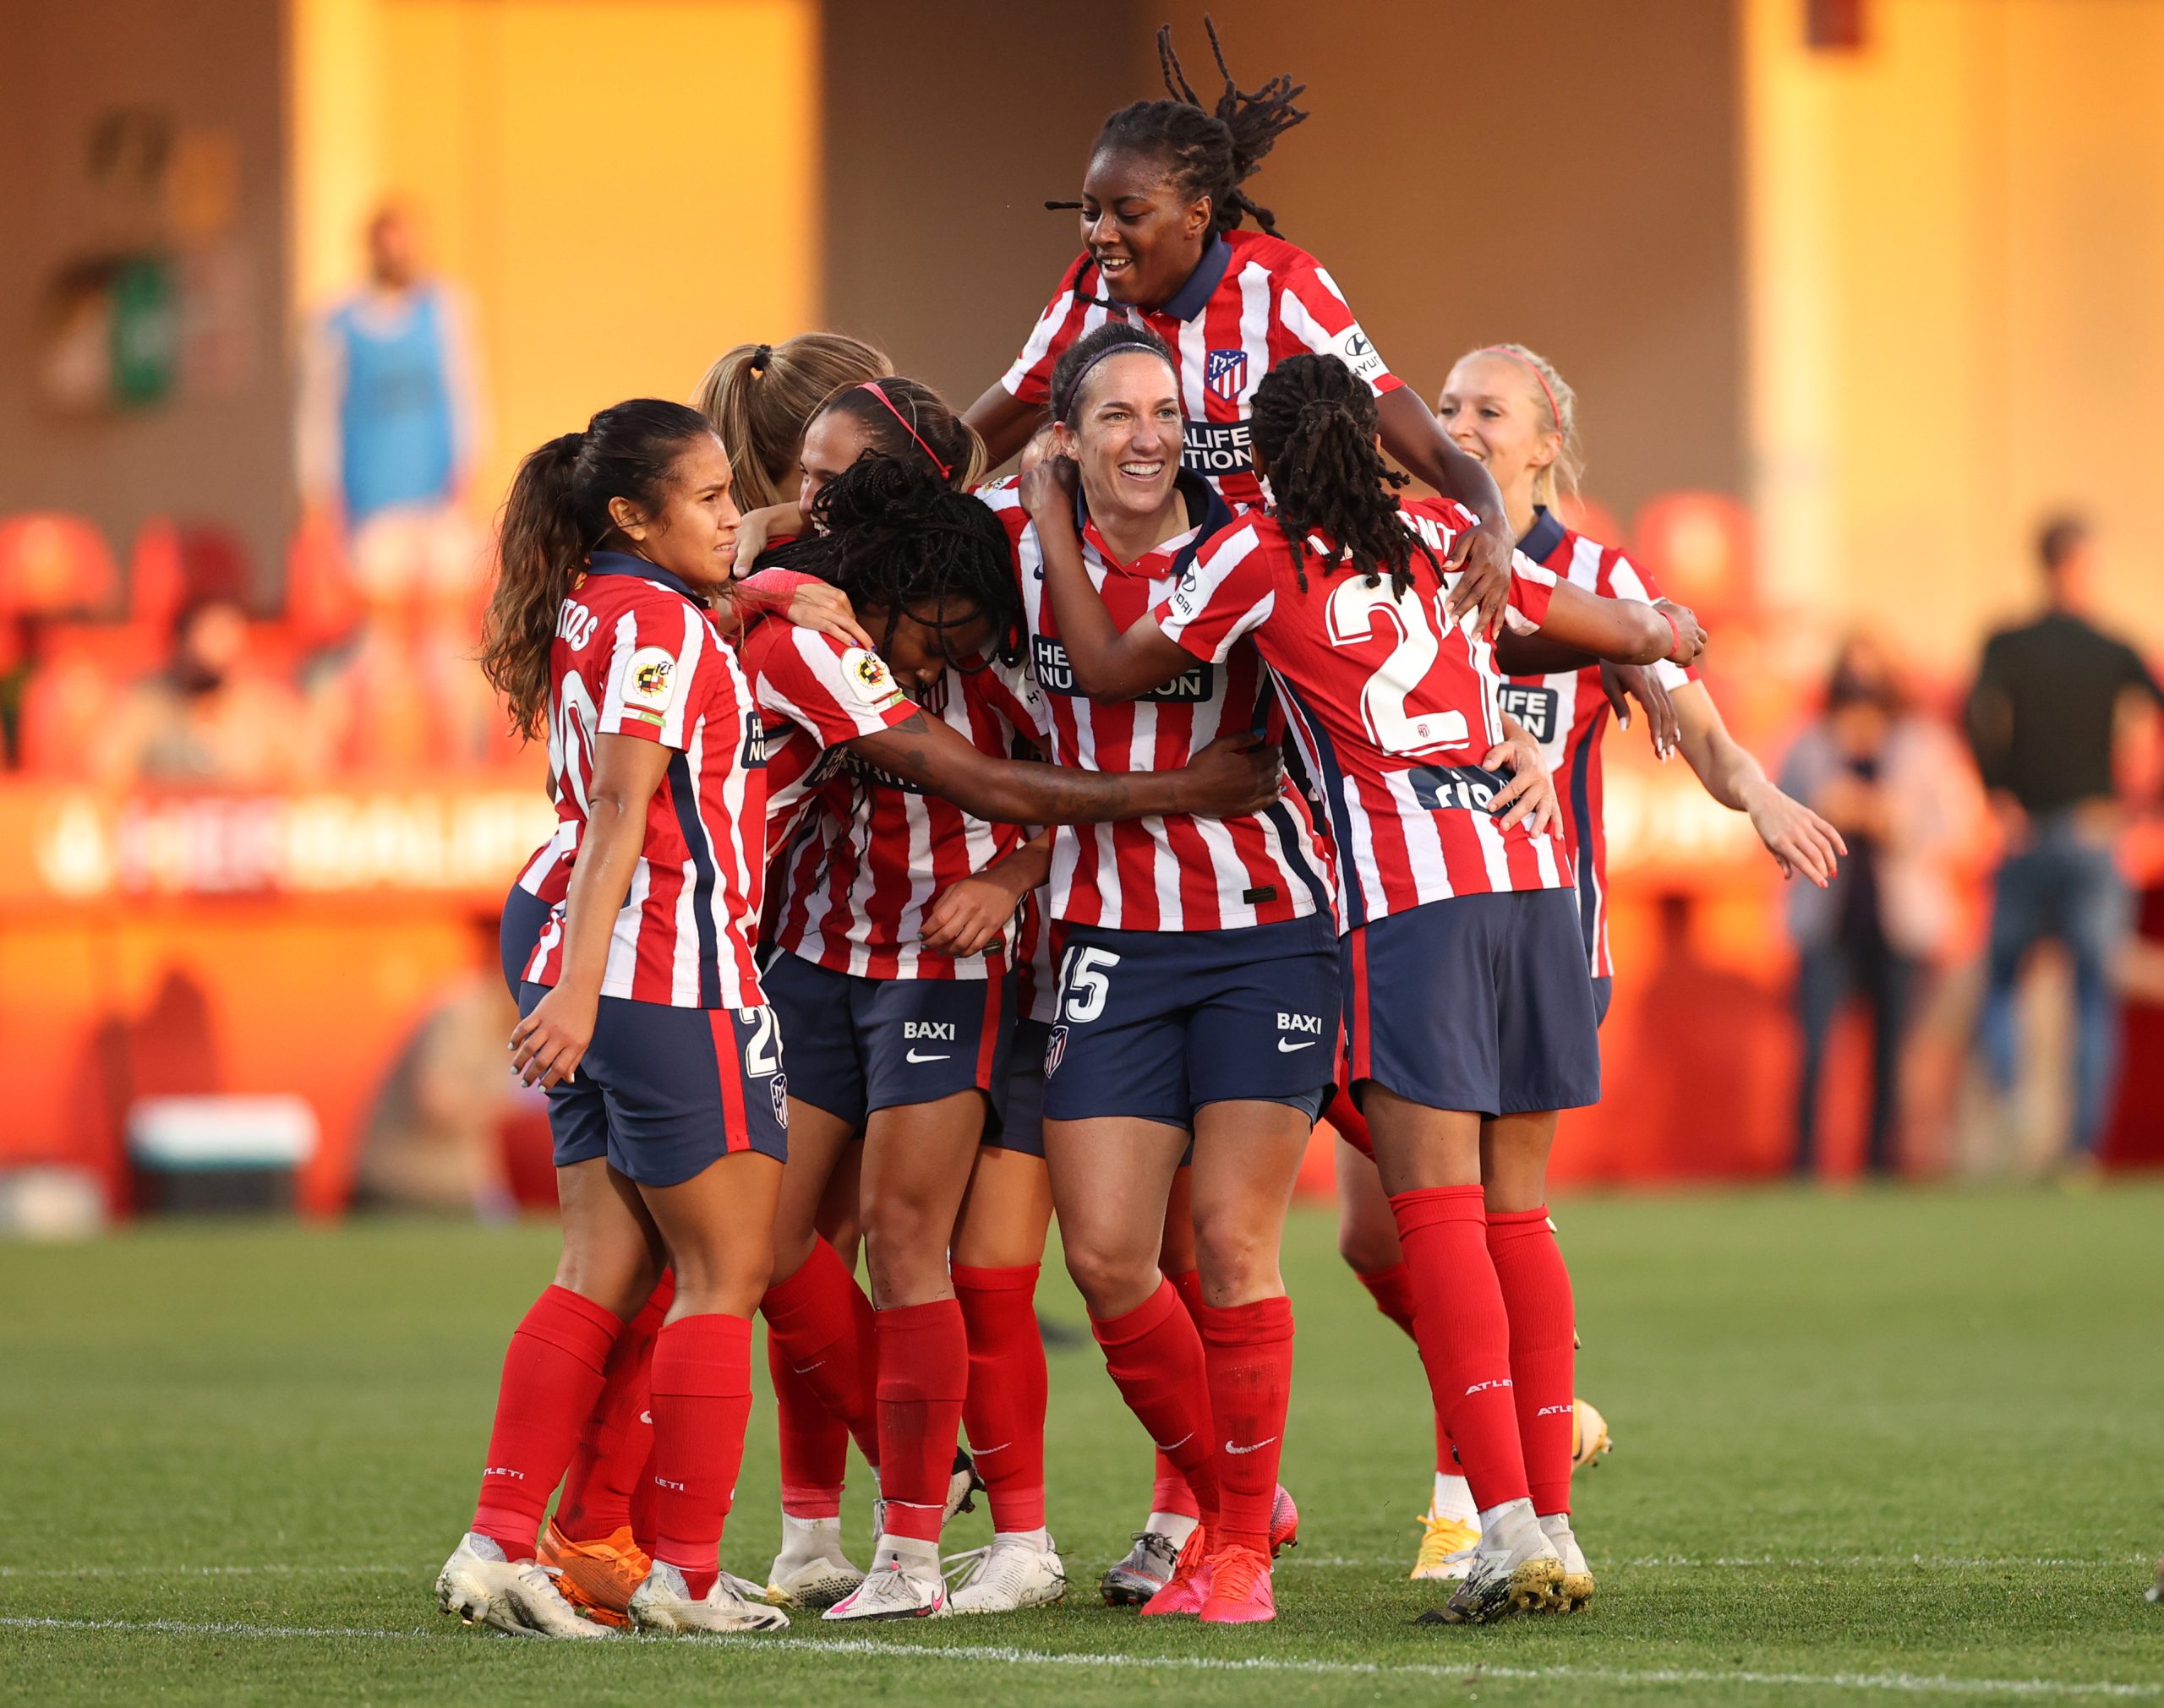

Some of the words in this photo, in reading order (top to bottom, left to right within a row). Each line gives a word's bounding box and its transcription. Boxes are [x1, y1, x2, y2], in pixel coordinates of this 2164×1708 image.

[1174, 591, 1193, 616] DAI
[904, 1021, 955, 1040] BAXI
[1276, 1012, 1322, 1034] BAXI
